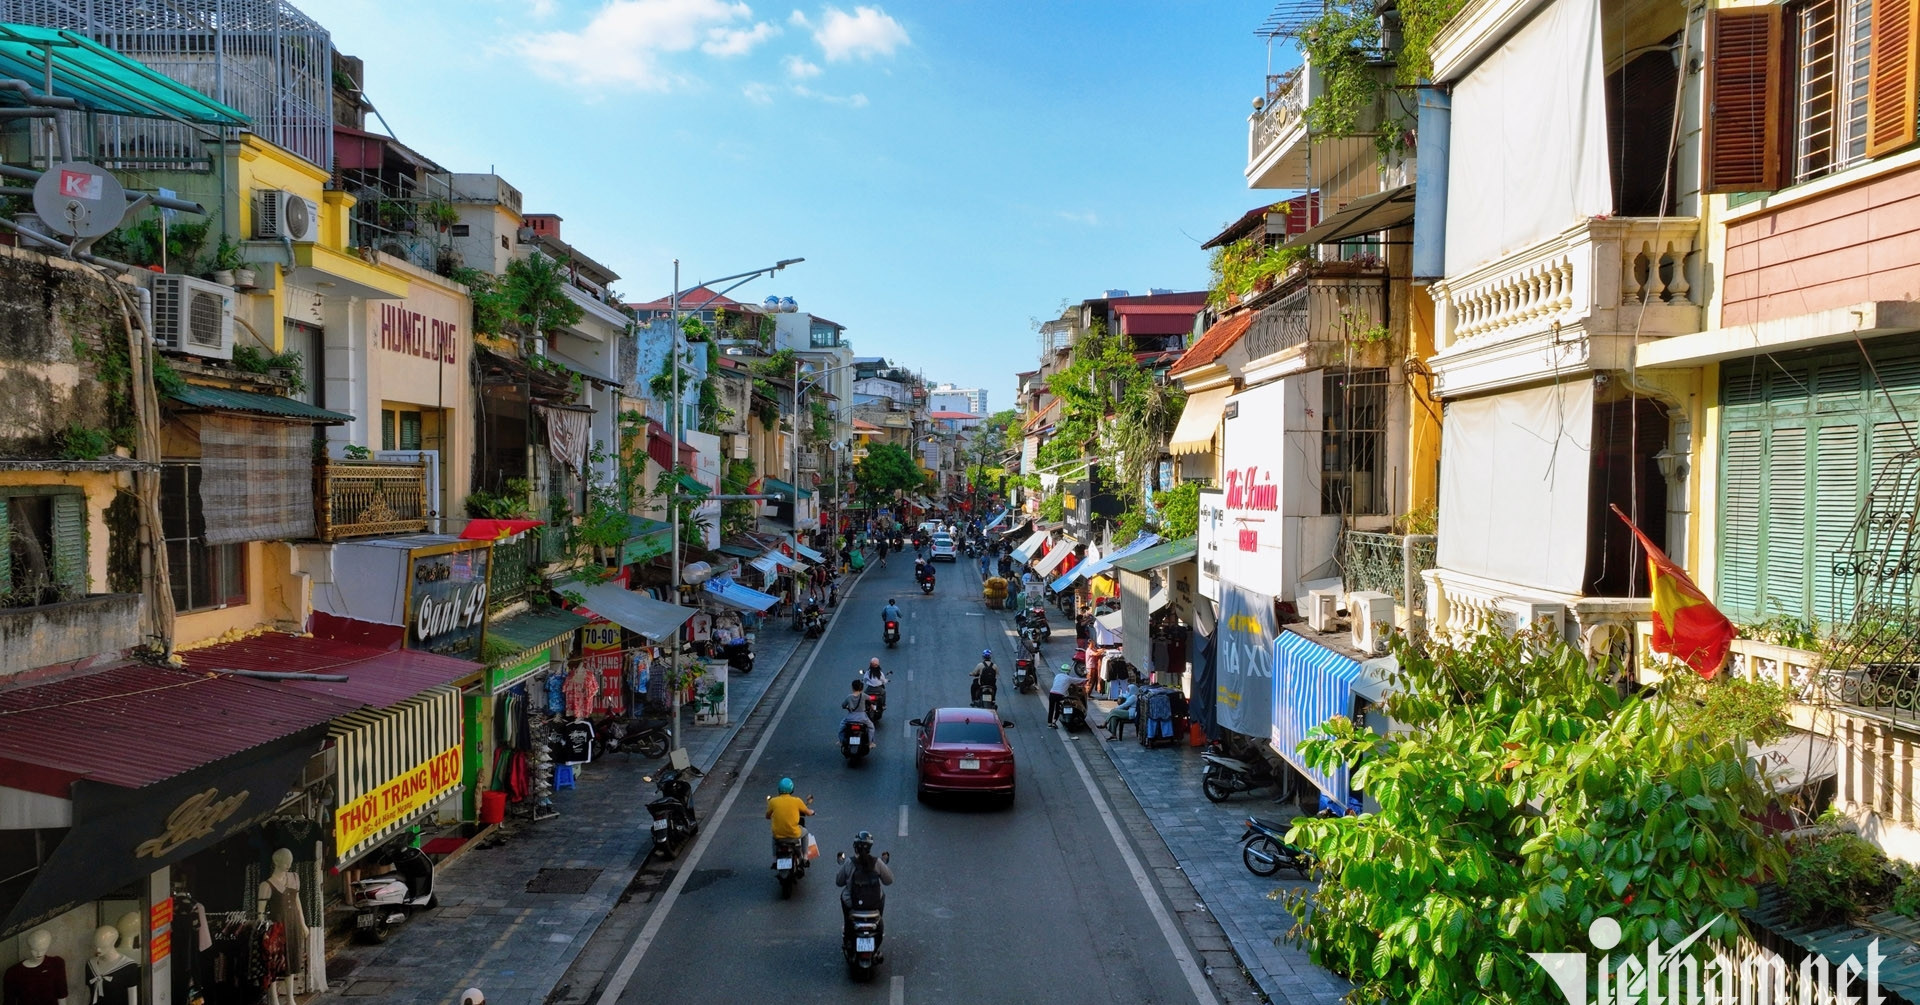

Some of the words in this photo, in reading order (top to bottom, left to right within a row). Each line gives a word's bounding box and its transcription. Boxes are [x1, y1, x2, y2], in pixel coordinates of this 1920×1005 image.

[417, 587, 462, 641] Oanh
[464, 583, 487, 629] 42
[1223, 633, 1240, 674] HÀ
[340, 794, 377, 836] THỜI
[382, 769, 427, 811] TRANG
